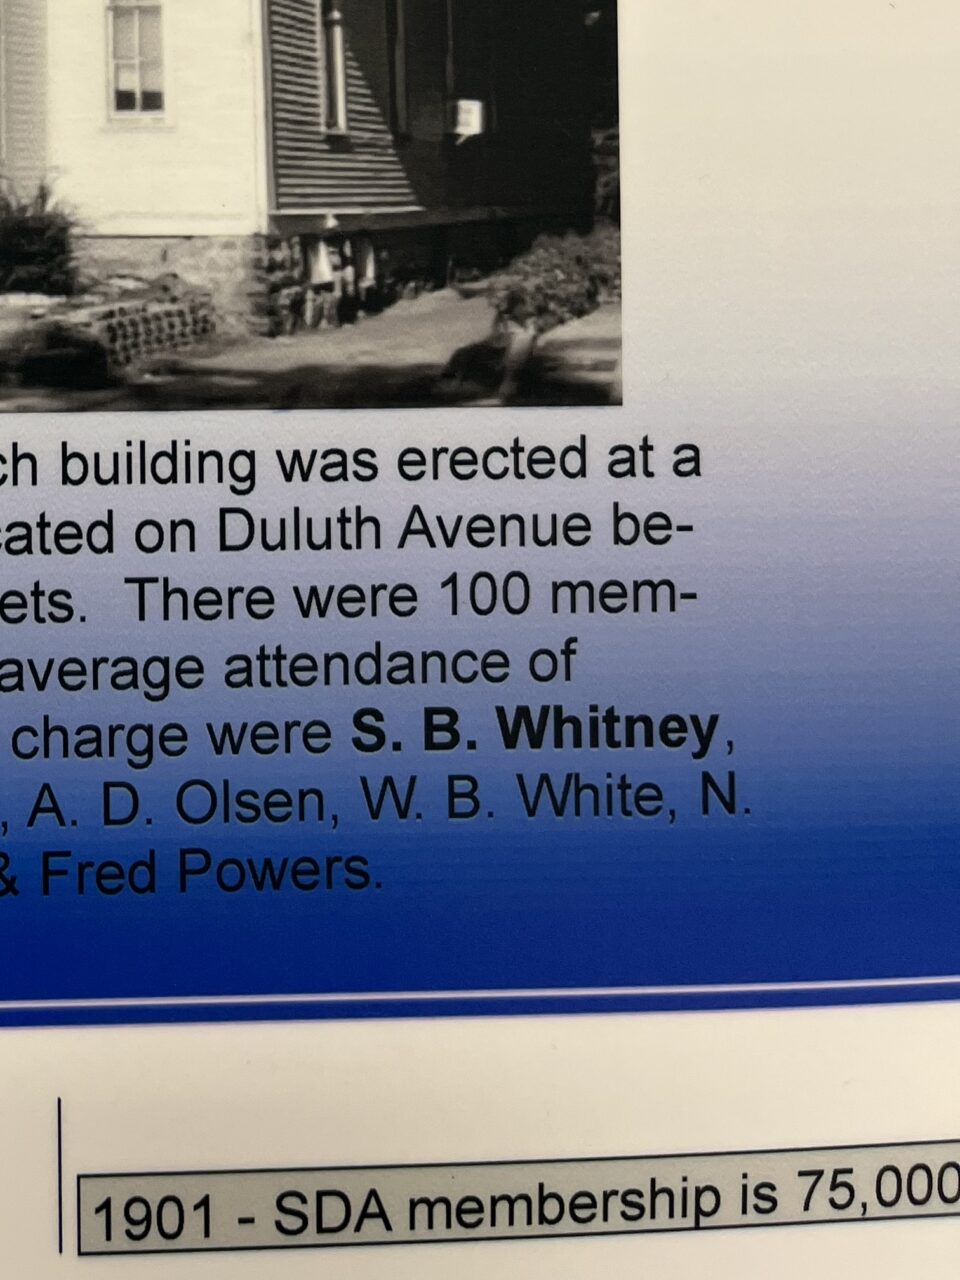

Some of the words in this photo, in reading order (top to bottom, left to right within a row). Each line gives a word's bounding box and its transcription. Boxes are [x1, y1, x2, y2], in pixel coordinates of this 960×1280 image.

[62, 440, 255, 495] building
[276, 448, 378, 482] was
[398, 435, 586, 481] erected
[608, 436, 654, 478] at
[673, 444, 701, 477] a
[135, 519, 195, 553] on
[220, 506, 380, 551] Duluth
[398, 505, 591, 548] Avenue
[614, 502, 693, 545] be-
[125, 577, 274, 621] There
[293, 584, 417, 618] were
[442, 571, 530, 615] 100
[552, 580, 697, 613] mem-
[225, 641, 509, 688] attendance
[530, 637, 577, 682] of
[12, 715, 187, 769] charge
[207, 720, 331, 755] were
[352, 708, 401, 752] S.
[424, 707, 476, 750] B.
[496, 705, 733, 759] Whitney,
[28, 783, 76, 826] A.
[104, 782, 151, 825] D.
[177, 780, 337, 828] Olsen,
[361, 776, 421, 819] W.
[448, 775, 493, 818] B.
[517, 773, 675, 823] White,
[702, 771, 750, 814] N.
[43, 850, 155, 895] Fred
[180, 848, 381, 892] Powers.
[94, 1194, 214, 1241] 1901
[275, 1189, 392, 1236] SDA
[410, 1177, 721, 1230] membership
[742, 1173, 777, 1214] is
[798, 1162, 960, 1216] 75,000
